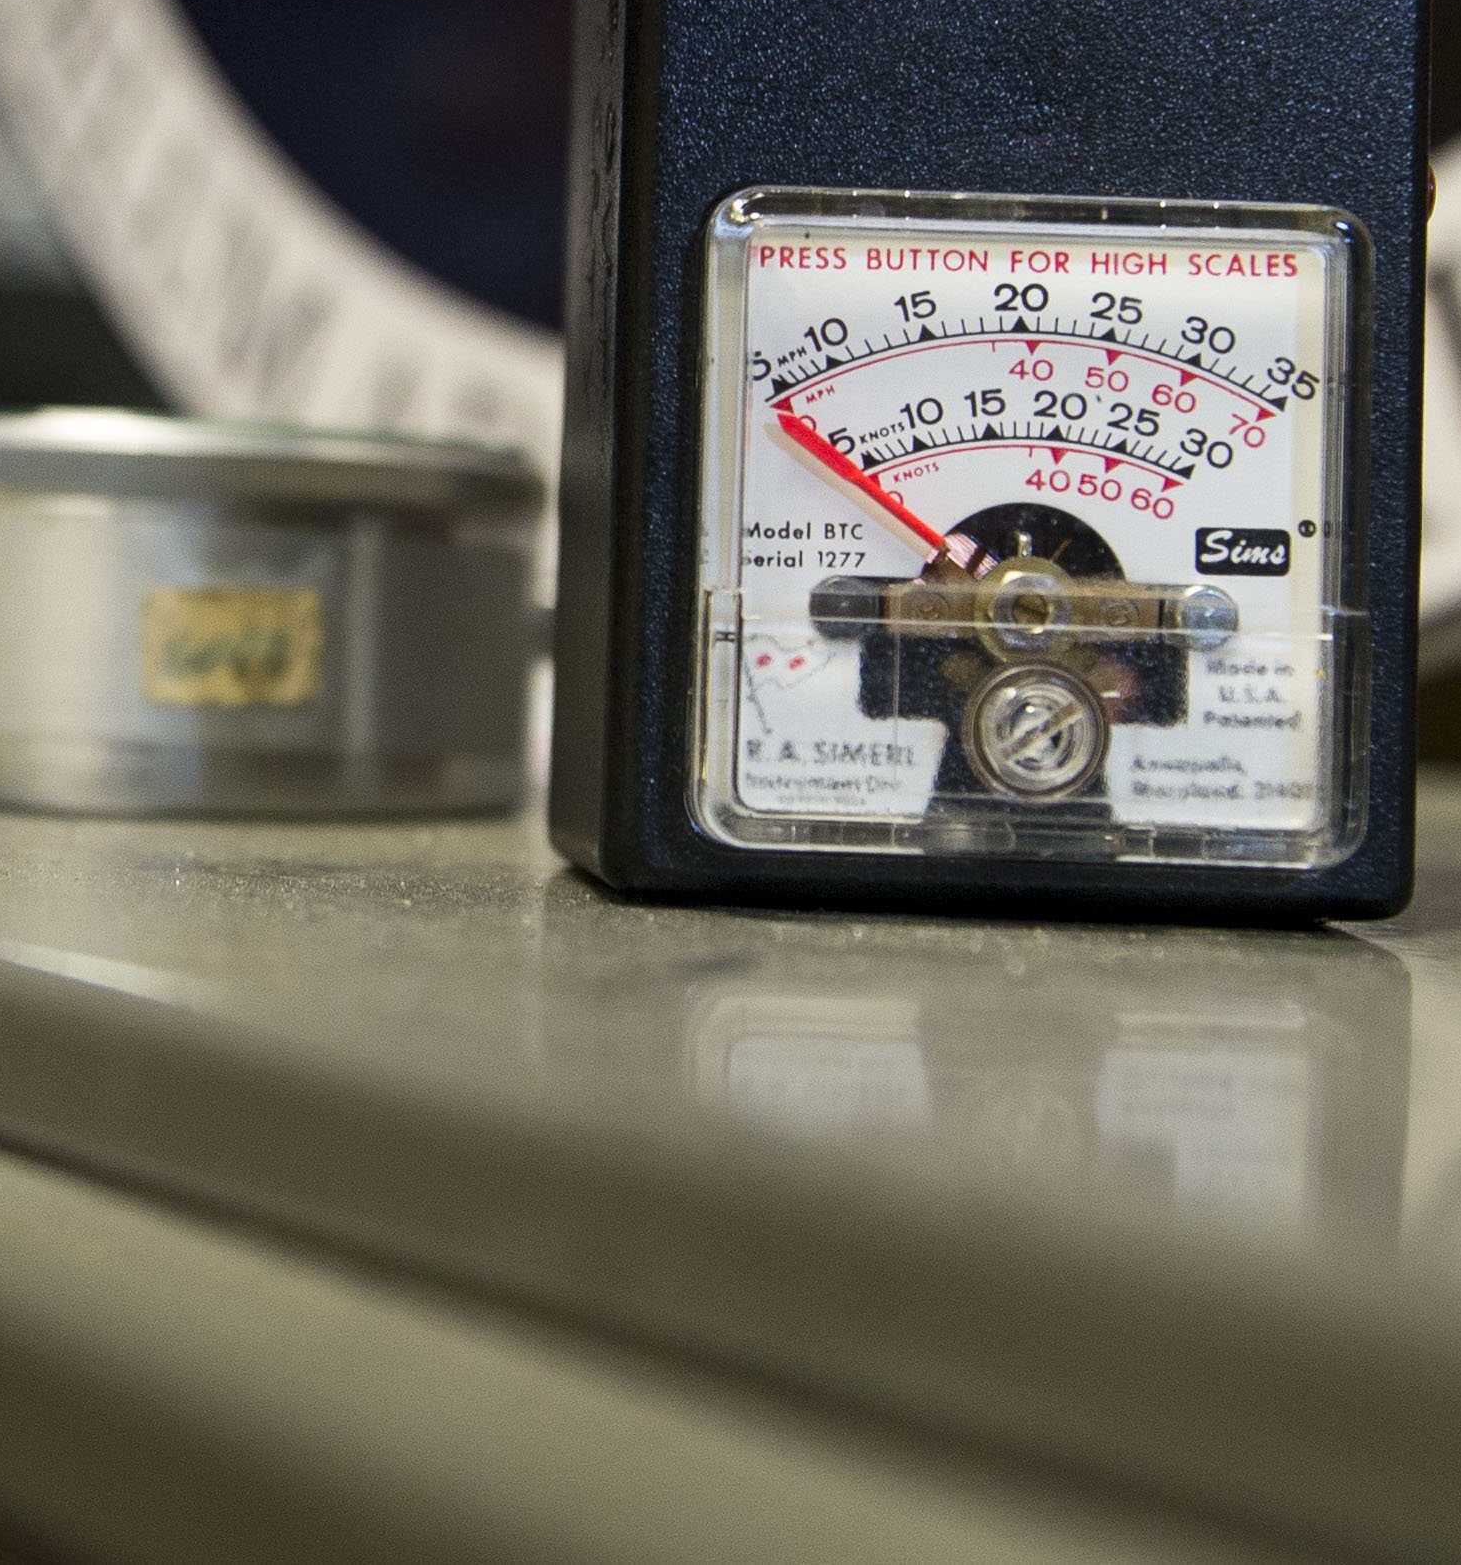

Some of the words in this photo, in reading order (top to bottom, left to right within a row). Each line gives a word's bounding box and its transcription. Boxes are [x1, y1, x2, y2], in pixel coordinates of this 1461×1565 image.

[760, 245, 847, 270] PRESS
[866, 247, 989, 272] BUTTON
[1010, 250, 1070, 274] FOR
[1091, 252, 1167, 275] HIGH
[1188, 253, 1299, 277] SCALES
[776, 346, 807, 367] MPH
[803, 317, 849, 353] 10
[893, 290, 937, 323] 15
[994, 283, 1049, 312] 20
[1090, 292, 1143, 325] 25
[1180, 315, 1236, 355] 30
[1266, 356, 1320, 401] 35
[805, 384, 836, 405] MPH
[1008, 359, 1054, 382] 40
[1084, 366, 1129, 394] 50
[1151, 383, 1196, 414] 60
[1228, 413, 1266, 448] 70
[828, 427, 856, 455] 5
[858, 420, 905, 445] KNOTS
[899, 397, 944, 429] 10
[963, 388, 1006, 418] 15
[1033, 390, 1087, 420] 20
[1106, 402, 1160, 437] 25
[1179, 428, 1233, 469] 30
[892, 462, 940, 484] KNOTS
[1025, 468, 1071, 492] 40
[1077, 473, 1122, 502] 50
[1130, 488, 1175, 520] 60
[745, 522, 811, 540] Model
[823, 523, 864, 540] BTC
[1200, 530, 1287, 565] Sims
[817, 551, 867, 568] 1277
